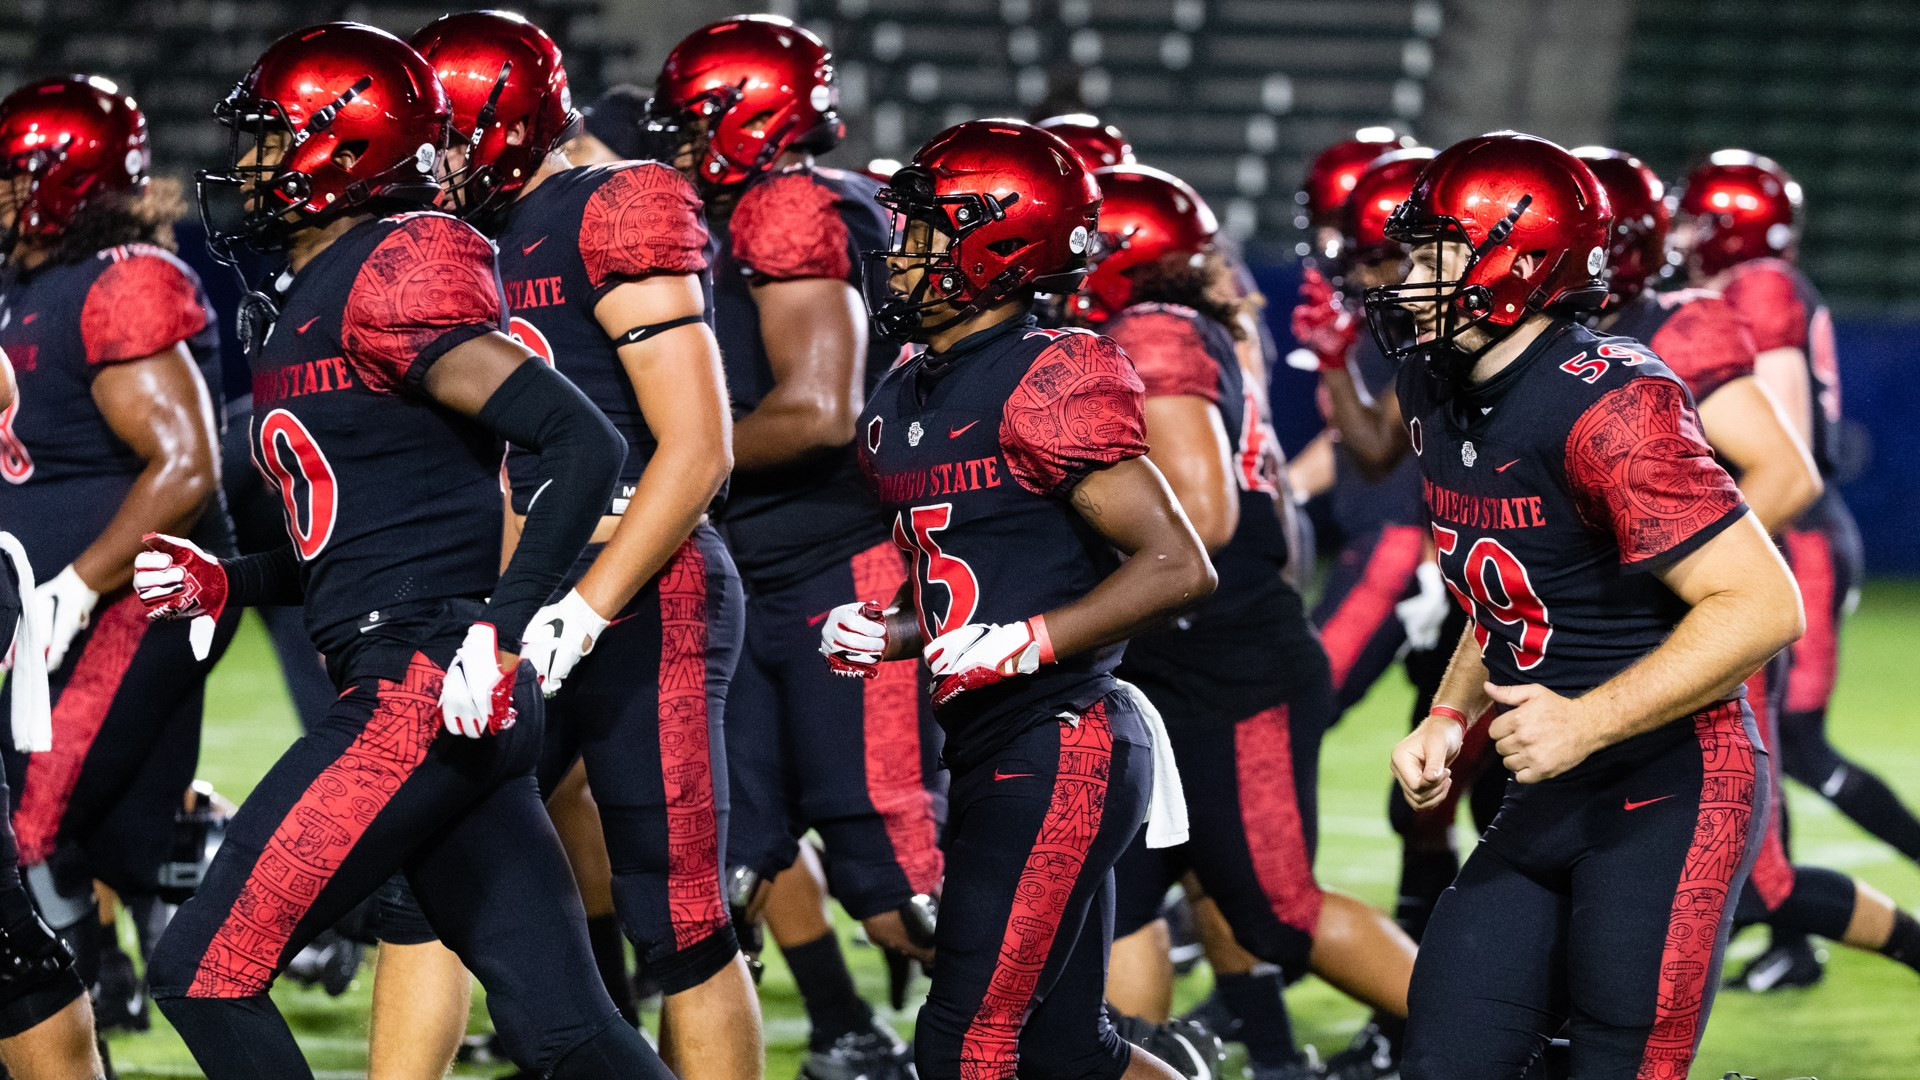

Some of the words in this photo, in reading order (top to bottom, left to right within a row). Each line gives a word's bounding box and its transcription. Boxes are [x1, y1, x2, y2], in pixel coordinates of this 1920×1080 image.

[504, 275, 566, 310] STATE
[280, 356, 353, 400] STATE
[1559, 343, 1646, 384] 59
[930, 456, 1001, 497] STATE
[1435, 485, 1479, 527] DIEGO
[1481, 496, 1546, 529] STATE
[368, 610, 380, 622] S
[1431, 521, 1554, 671] 59
